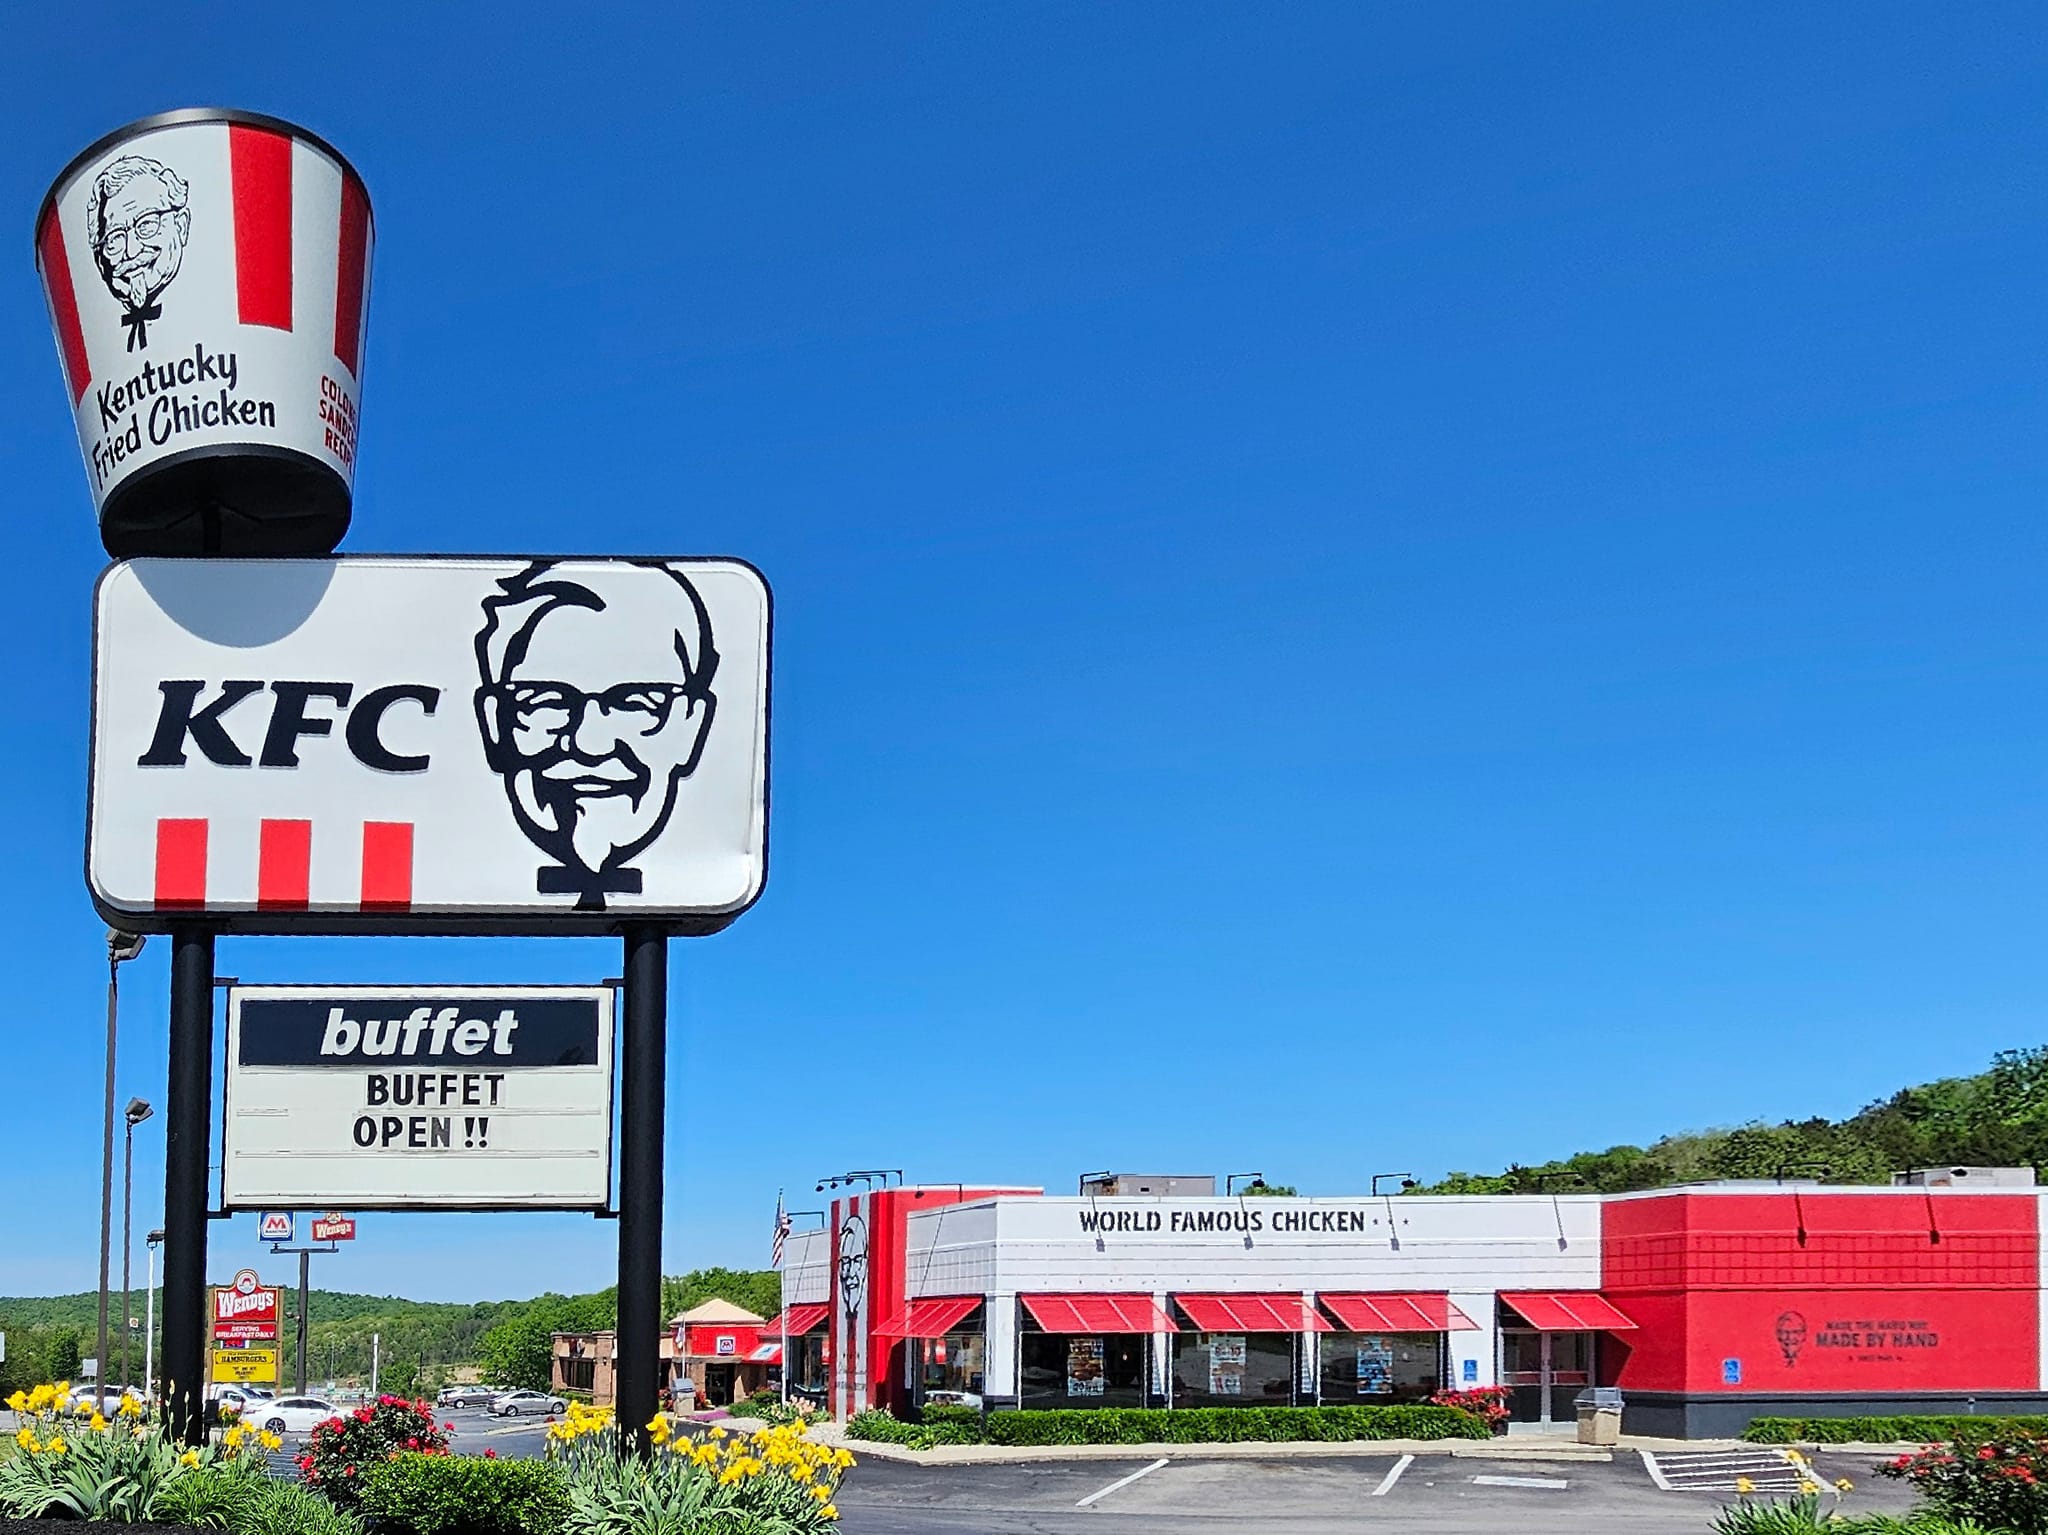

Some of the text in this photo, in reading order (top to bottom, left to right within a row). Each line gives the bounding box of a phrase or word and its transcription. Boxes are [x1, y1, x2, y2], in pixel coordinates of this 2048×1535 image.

[96, 343, 238, 432] Kentucky
[91, 389, 276, 490] Fried Chicken
[137, 679, 441, 773] KFC
[319, 1007, 519, 1057] buffet
[366, 1073, 505, 1107] BUFFET
[352, 1115, 451, 1149] OPEN
[1079, 1210, 1366, 1233] WORLD FAMOUS CHICKEN
[1815, 1332, 1939, 1348] MADE BY HAND
